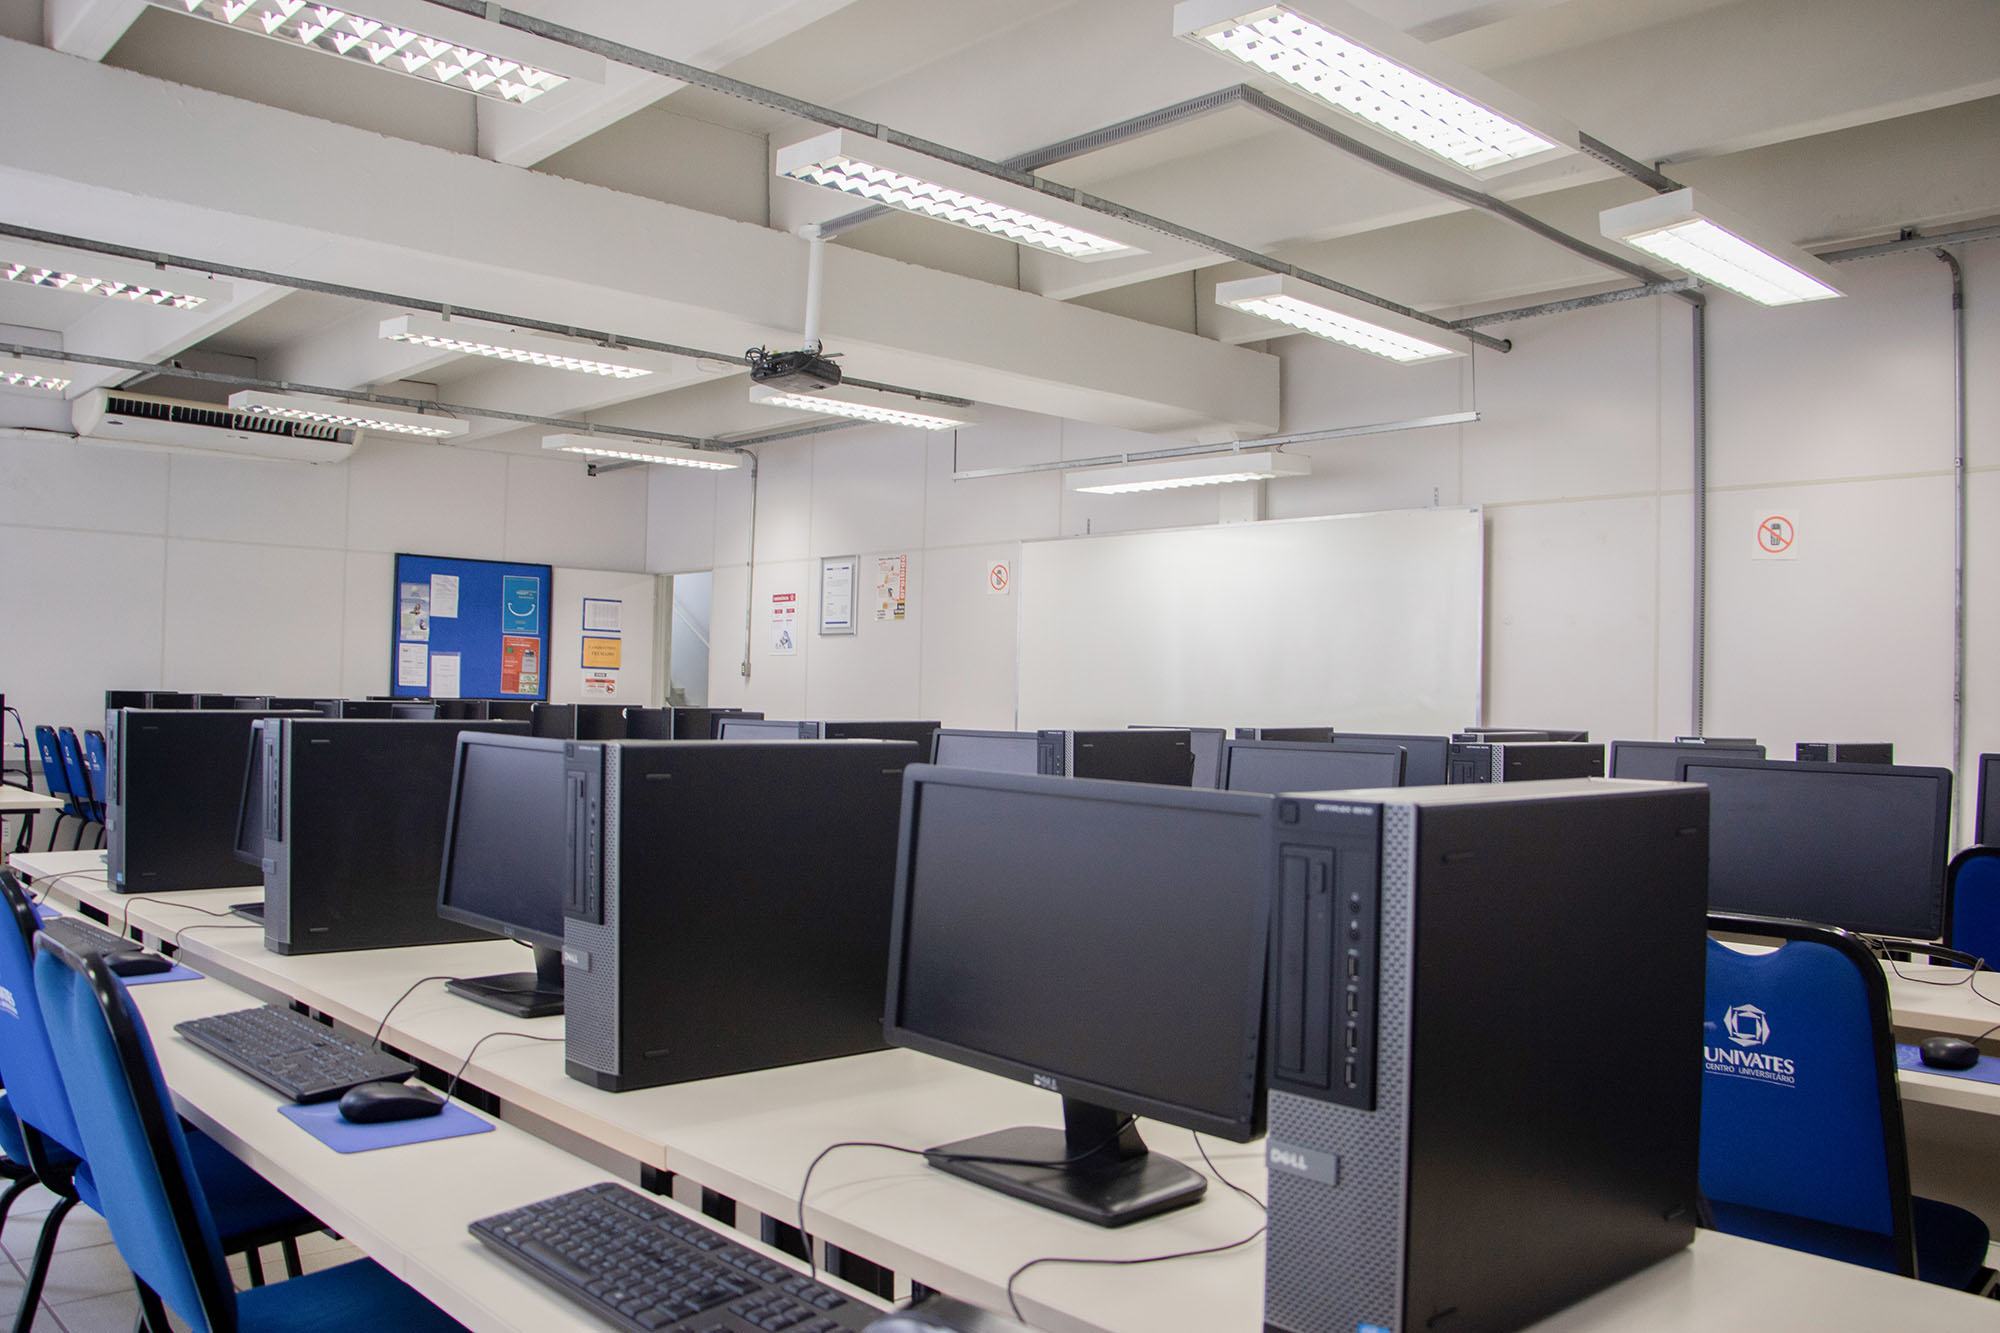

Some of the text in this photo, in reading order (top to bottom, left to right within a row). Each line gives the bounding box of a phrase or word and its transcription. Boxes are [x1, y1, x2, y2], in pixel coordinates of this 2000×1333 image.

[1704, 1046, 1795, 1074] UNIVATES
[1705, 1062, 1795, 1084] CENTRO UNIVERSITÁRIO
[1271, 1148, 1307, 1170] DELL
